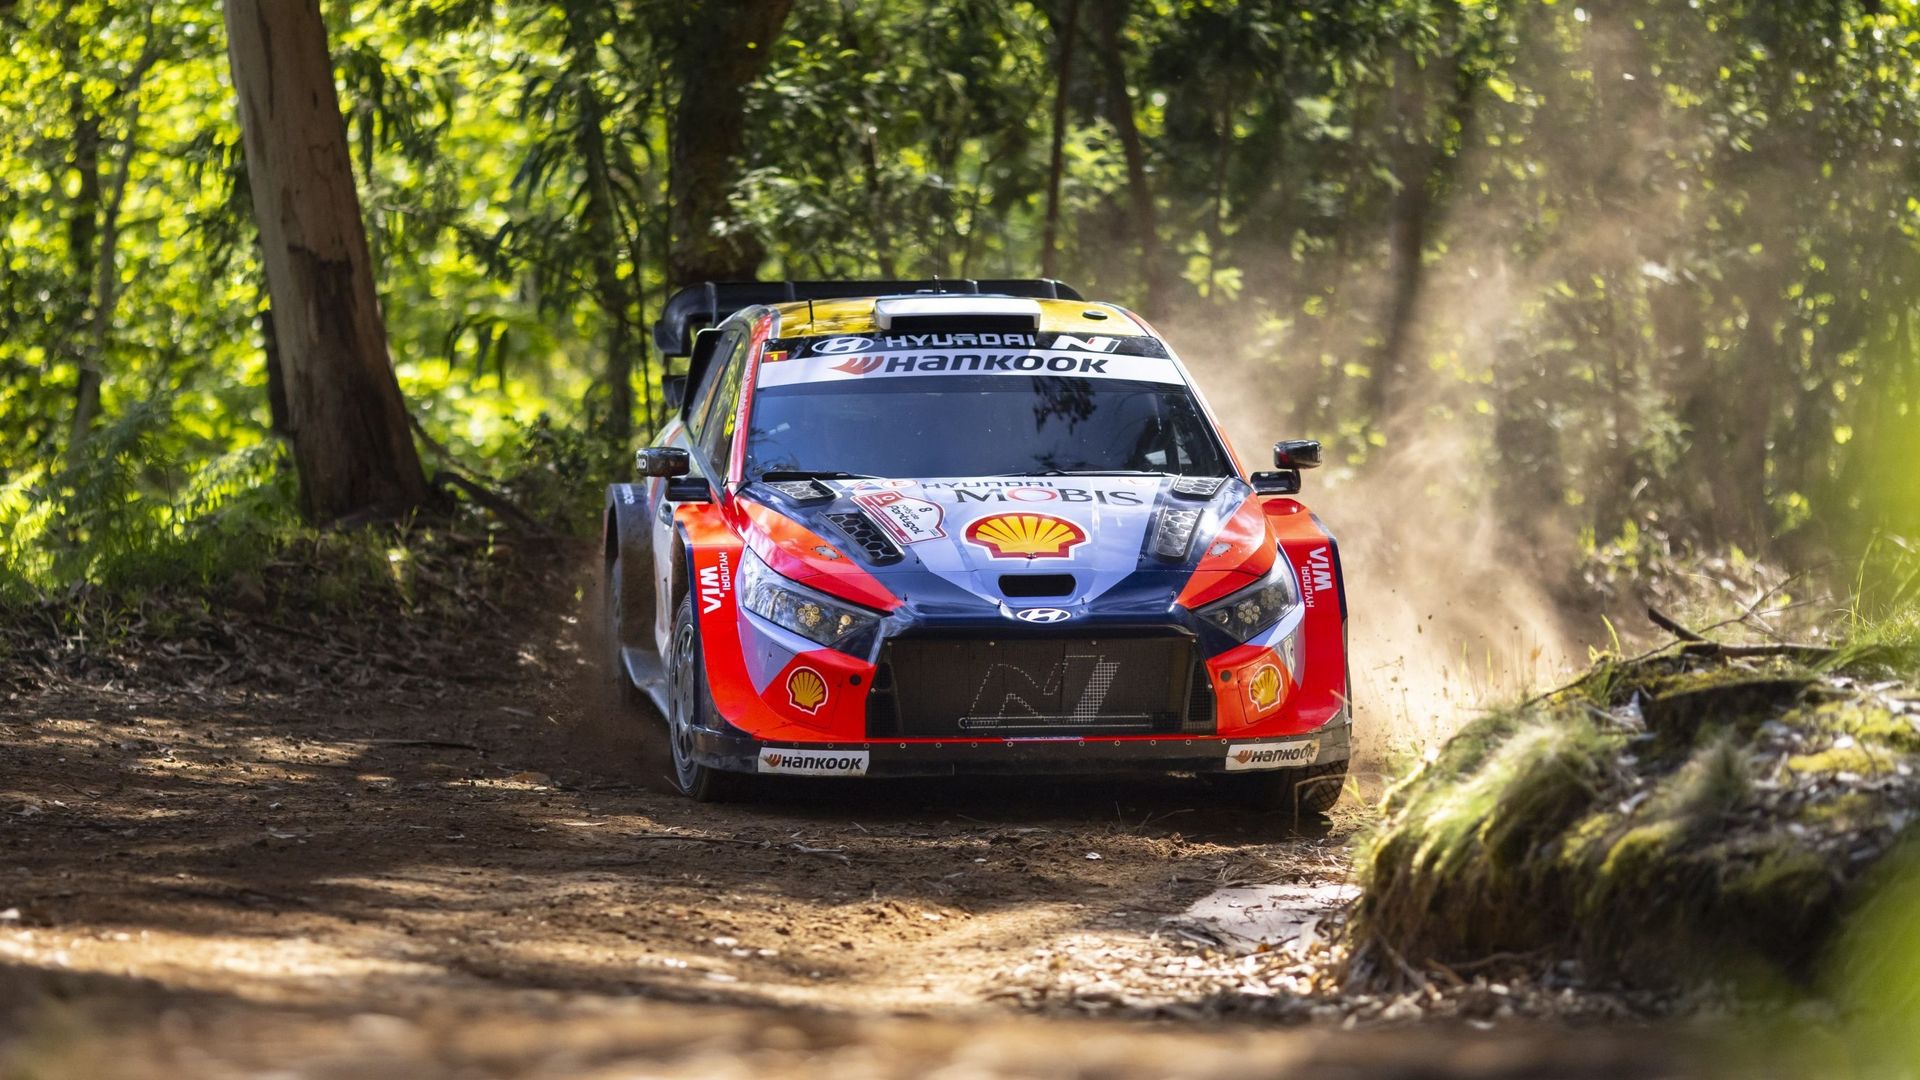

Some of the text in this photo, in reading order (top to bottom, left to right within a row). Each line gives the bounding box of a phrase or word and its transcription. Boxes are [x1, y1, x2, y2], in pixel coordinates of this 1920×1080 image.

[885, 333, 1036, 348] HYUNDAI
[921, 481, 1054, 489] HYUNDAI
[953, 488, 1144, 507] MOBIS
[719, 552, 731, 591] HYUNDAI
[1301, 566, 1315, 608] HYUNDAI
